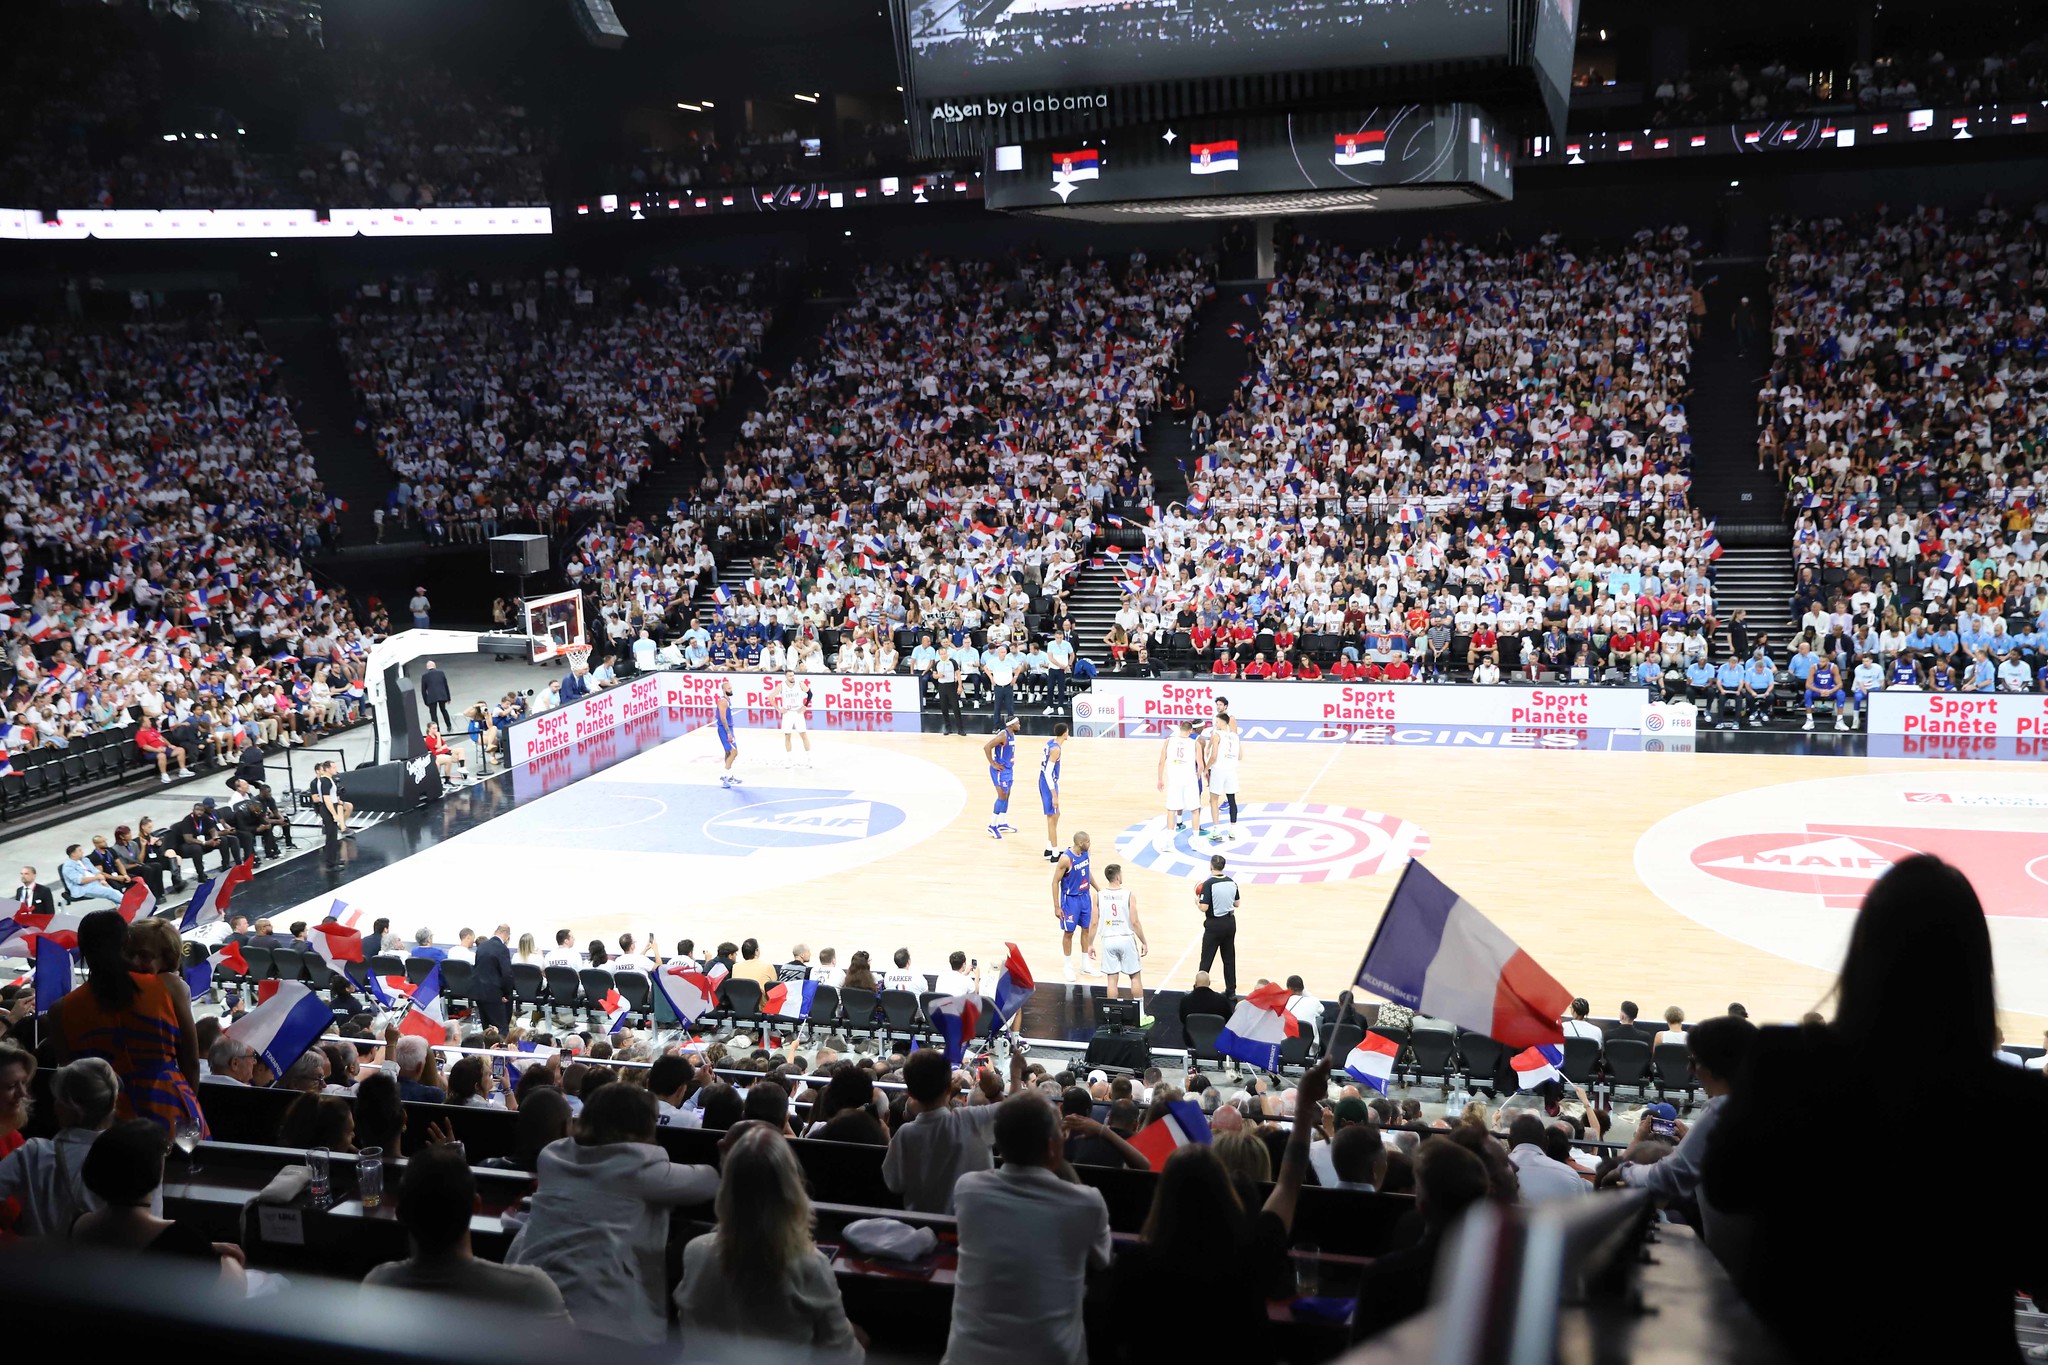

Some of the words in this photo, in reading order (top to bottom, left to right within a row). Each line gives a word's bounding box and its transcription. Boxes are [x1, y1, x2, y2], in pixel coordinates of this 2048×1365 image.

[932, 103, 981, 122] Absen
[987, 99, 1007, 117] by
[1012, 95, 1107, 113] alabama
[631, 678, 657, 699] Sport
[842, 678, 891, 696] Sport
[1162, 684, 1213, 702] Sport
[667, 690, 720, 706] Planèt
[825, 692, 892, 709] Planète
[1342, 687, 1395, 706] Sport
[1532, 691, 1588, 709] Sport
[585, 694, 613, 718] Sport
[623, 695, 658, 718] Planète
[1145, 698, 1213, 716] Planète
[1323, 702, 1396, 720] Planète
[1512, 706, 1588, 724] Planète
[1929, 696, 1998, 718] Sport
[537, 711, 568, 736] Sport
[576, 712, 614, 738] Planète
[1671, 719, 1692, 728] FFBB
[1904, 714, 1997, 734] Planète
[527, 729, 569, 757] Planète
[1129, 724, 1579, 747] LN-DÉCINES
[752, 814, 869, 828] MAIF
[1742, 853, 1889, 869] MAIF
[1111, 903, 1118, 917] 9
